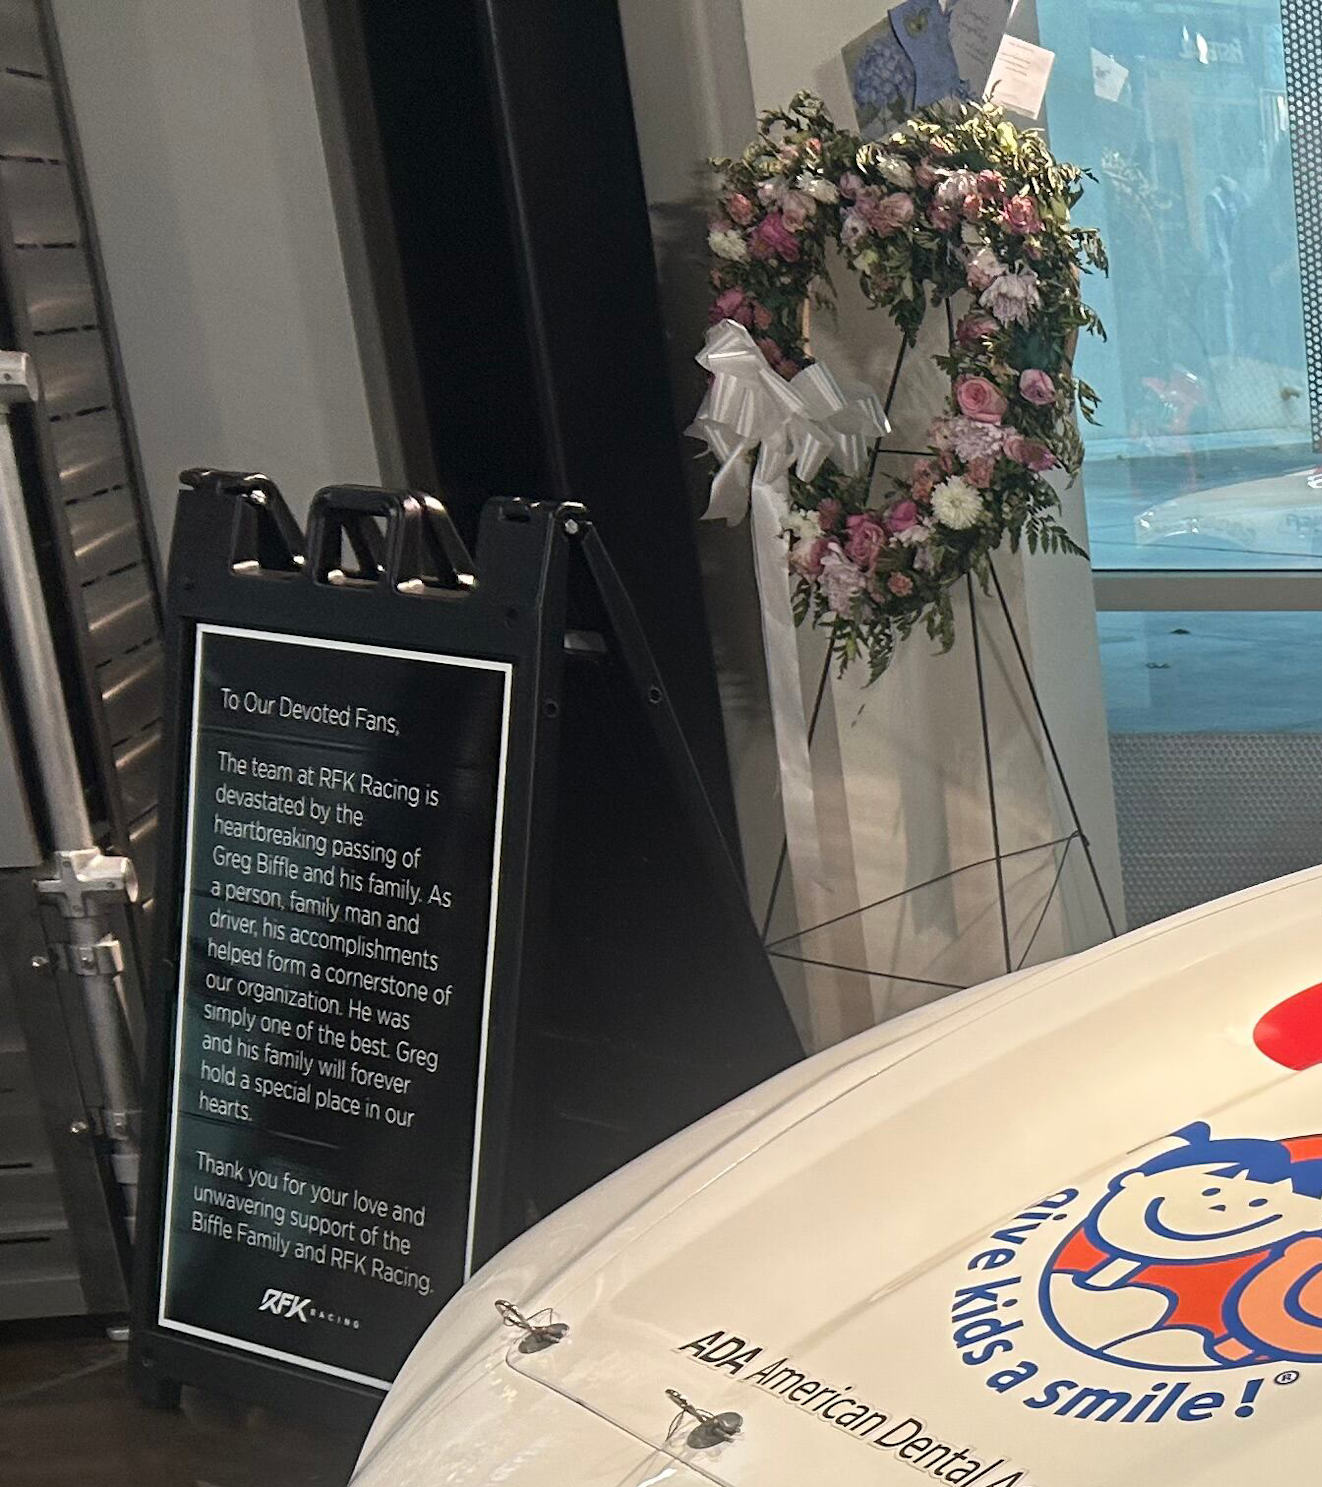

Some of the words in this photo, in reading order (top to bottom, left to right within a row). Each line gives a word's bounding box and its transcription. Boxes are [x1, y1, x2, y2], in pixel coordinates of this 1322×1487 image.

[220, 687, 240, 710] To
[243, 691, 276, 714] Our
[279, 695, 351, 726] Devoted
[355, 707, 399, 736] Fans,
[217, 750, 247, 774] The
[251, 757, 292, 782] team
[296, 766, 315, 786] at
[318, 766, 355, 792] RFK
[360, 773, 419, 807] Racing
[425, 783, 439, 806] is
[212, 844, 251, 874] Greg
[256, 852, 298, 879] Biffle
[302, 865, 334, 886] and
[339, 867, 363, 891] his
[368, 872, 422, 905] family.
[426, 884, 451, 907] As
[193, 1185, 285, 1226] unwavering
[289, 1210, 355, 1241] support
[359, 1225, 379, 1246] of
[382, 1230, 410, 1255] the
[195, 1150, 243, 1180] Thank
[247, 1168, 277, 1189] you
[282, 1171, 307, 1195] for
[309, 1184, 348, 1206] your
[353, 1189, 388, 1217] love
[392, 1204, 425, 1226] and
[191, 1210, 232, 1239] Biffle
[237, 1222, 290, 1257] Family
[294, 1242, 326, 1263] and
[330, 1247, 366, 1275] RFK
[371, 1257, 433, 1295] Racing.
[968, 1188, 1079, 1270] give
[258, 1289, 311, 1323] RFK
[310, 1308, 360, 1330] RACING
[951, 1276, 1024, 1366] kids
[678, 1330, 763, 1374] ADA
[744, 1357, 888, 1436] American
[873, 1417, 1004, 1487] Dental
[986, 1360, 1039, 1393] a
